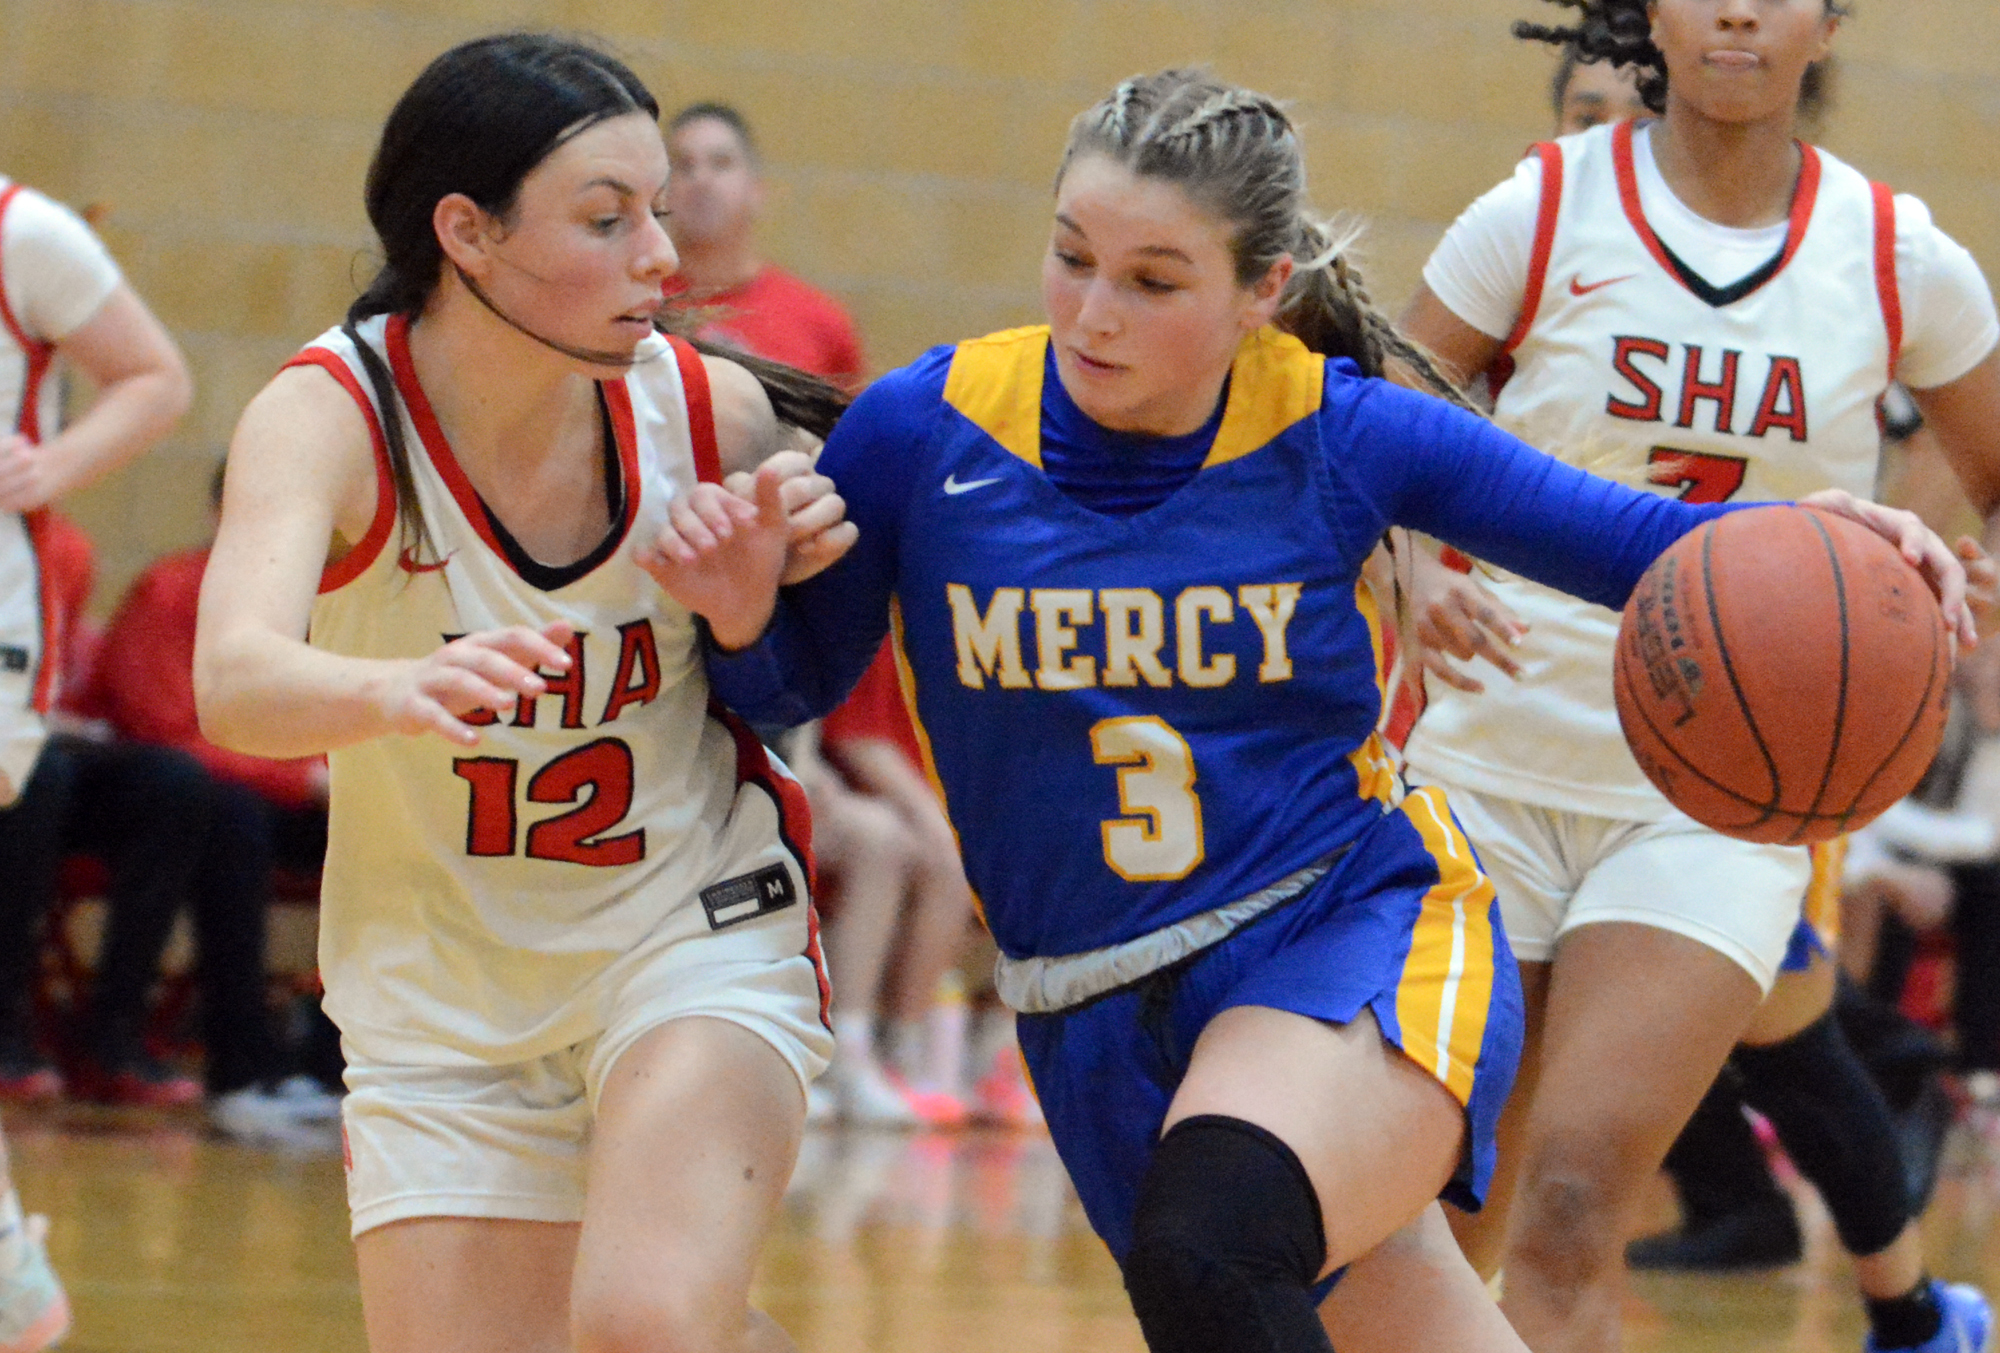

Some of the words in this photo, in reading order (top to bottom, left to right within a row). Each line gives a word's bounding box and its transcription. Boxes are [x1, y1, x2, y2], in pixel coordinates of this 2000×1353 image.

[1607, 335, 1807, 441] SHA
[442, 617, 659, 728] HA
[947, 583, 1302, 690] MERCY
[453, 737, 645, 866] 12
[1089, 715, 1204, 882] 3
[766, 878, 784, 899] M
